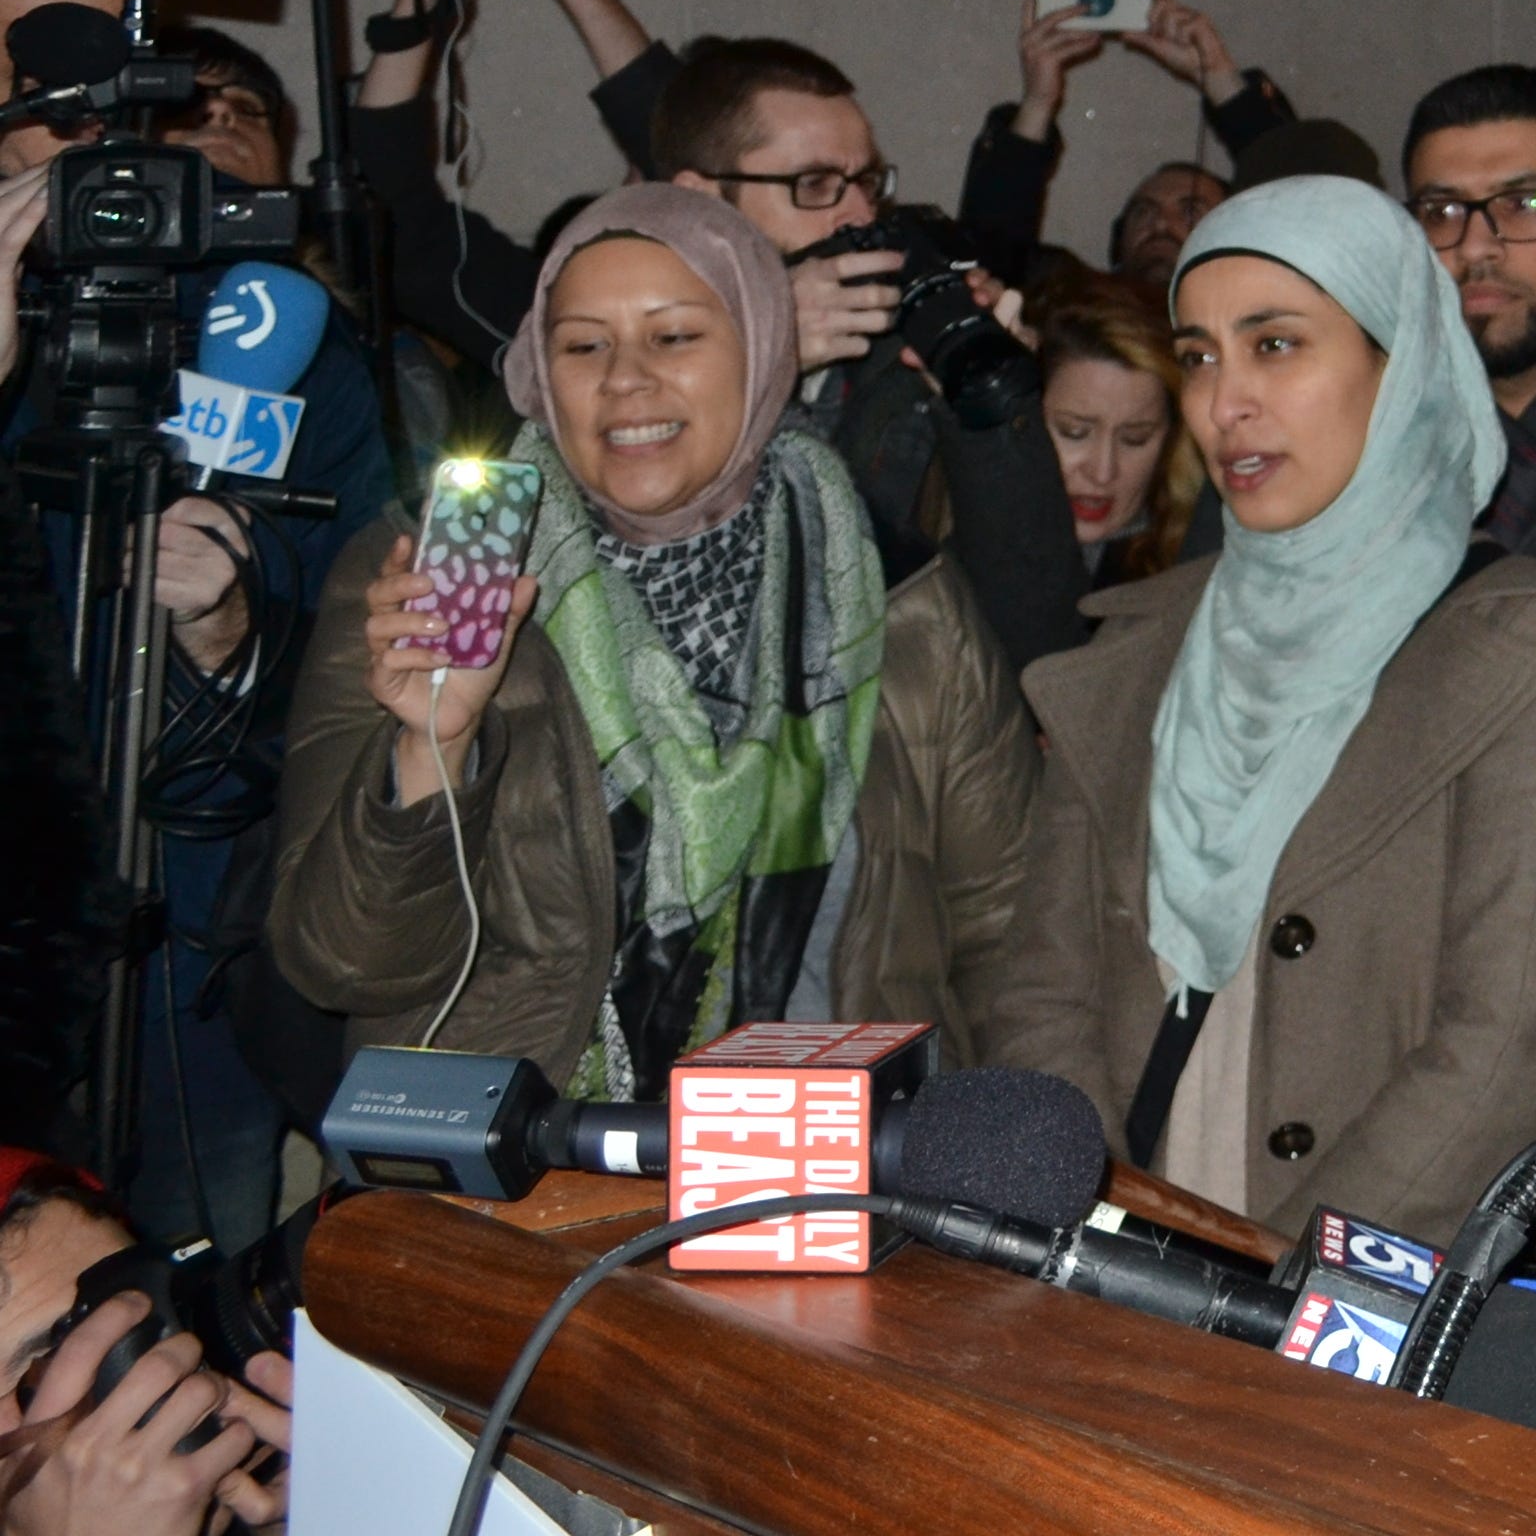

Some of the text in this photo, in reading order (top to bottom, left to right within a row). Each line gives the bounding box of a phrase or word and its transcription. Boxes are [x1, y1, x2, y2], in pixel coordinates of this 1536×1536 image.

[351, 1103, 446, 1120] SENNHEISER
[804, 1075, 861, 1147] THE
[679, 1077, 796, 1262] BEAST
[1323, 1215, 1345, 1263] NEWS
[1349, 1234, 1435, 1287] 5
[1284, 1299, 1329, 1361] NE
